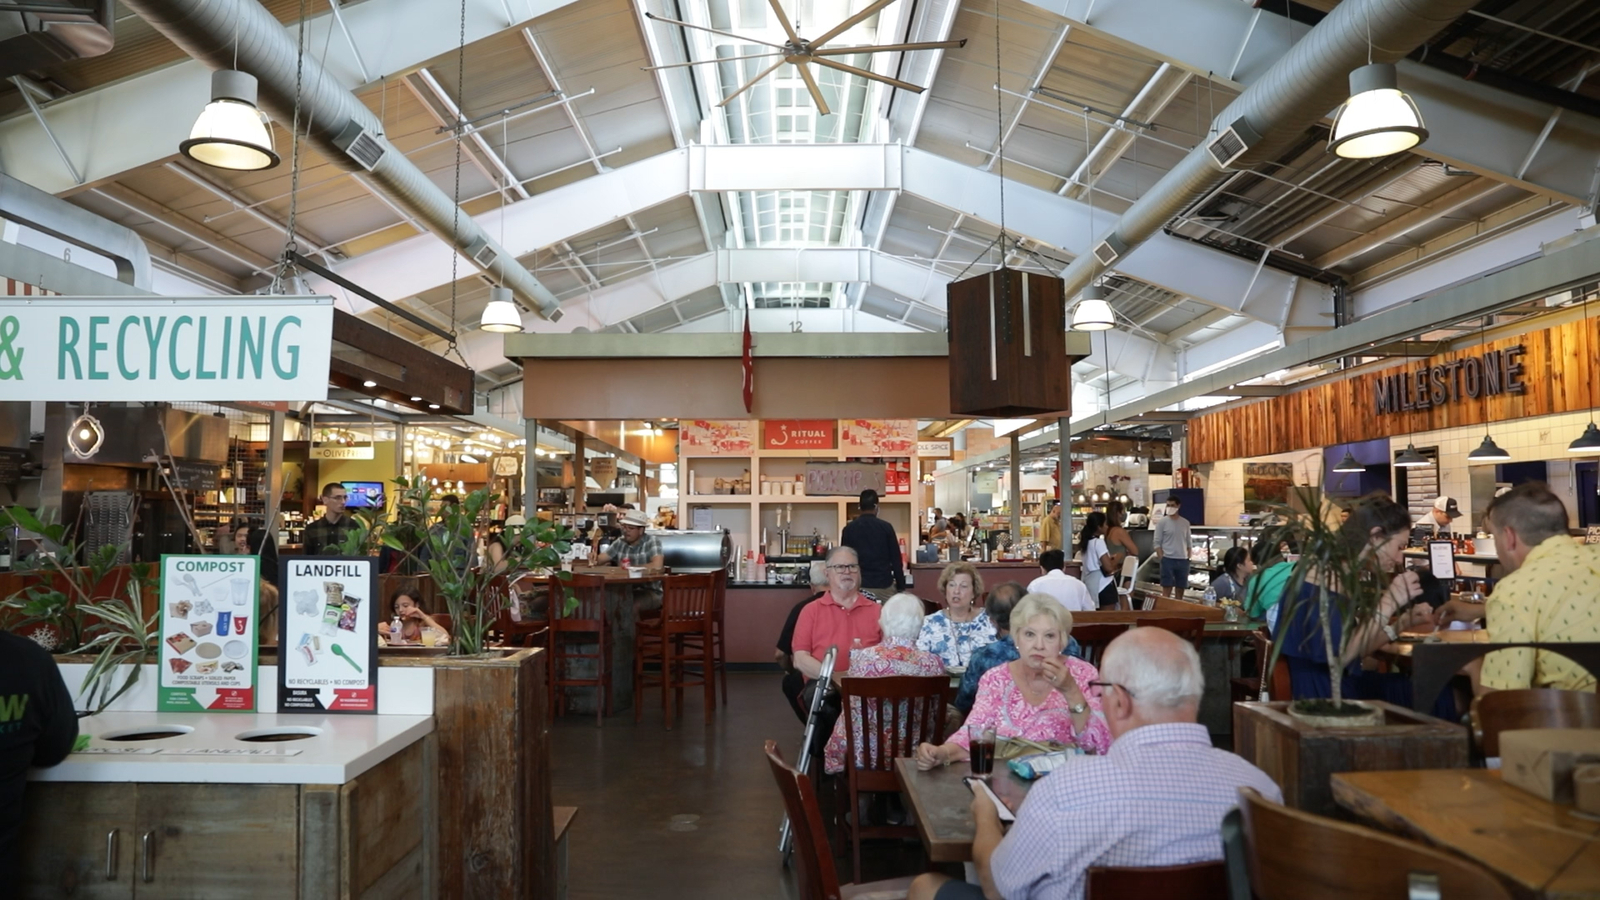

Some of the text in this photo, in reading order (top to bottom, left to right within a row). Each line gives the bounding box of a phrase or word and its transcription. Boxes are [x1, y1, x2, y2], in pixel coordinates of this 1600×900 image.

[63, 248, 72, 263] 6
[789, 321, 803, 333] 12
[0, 315, 302, 381] & RECYCLING
[1374, 344, 1526, 416] MILESTONE
[791, 430, 826, 438] RITUAL
[808, 470, 862, 492] PICK UP
[176, 561, 245, 572] COMPOST
[295, 564, 361, 577] LANDFILL
[0, 694, 29, 721] W
